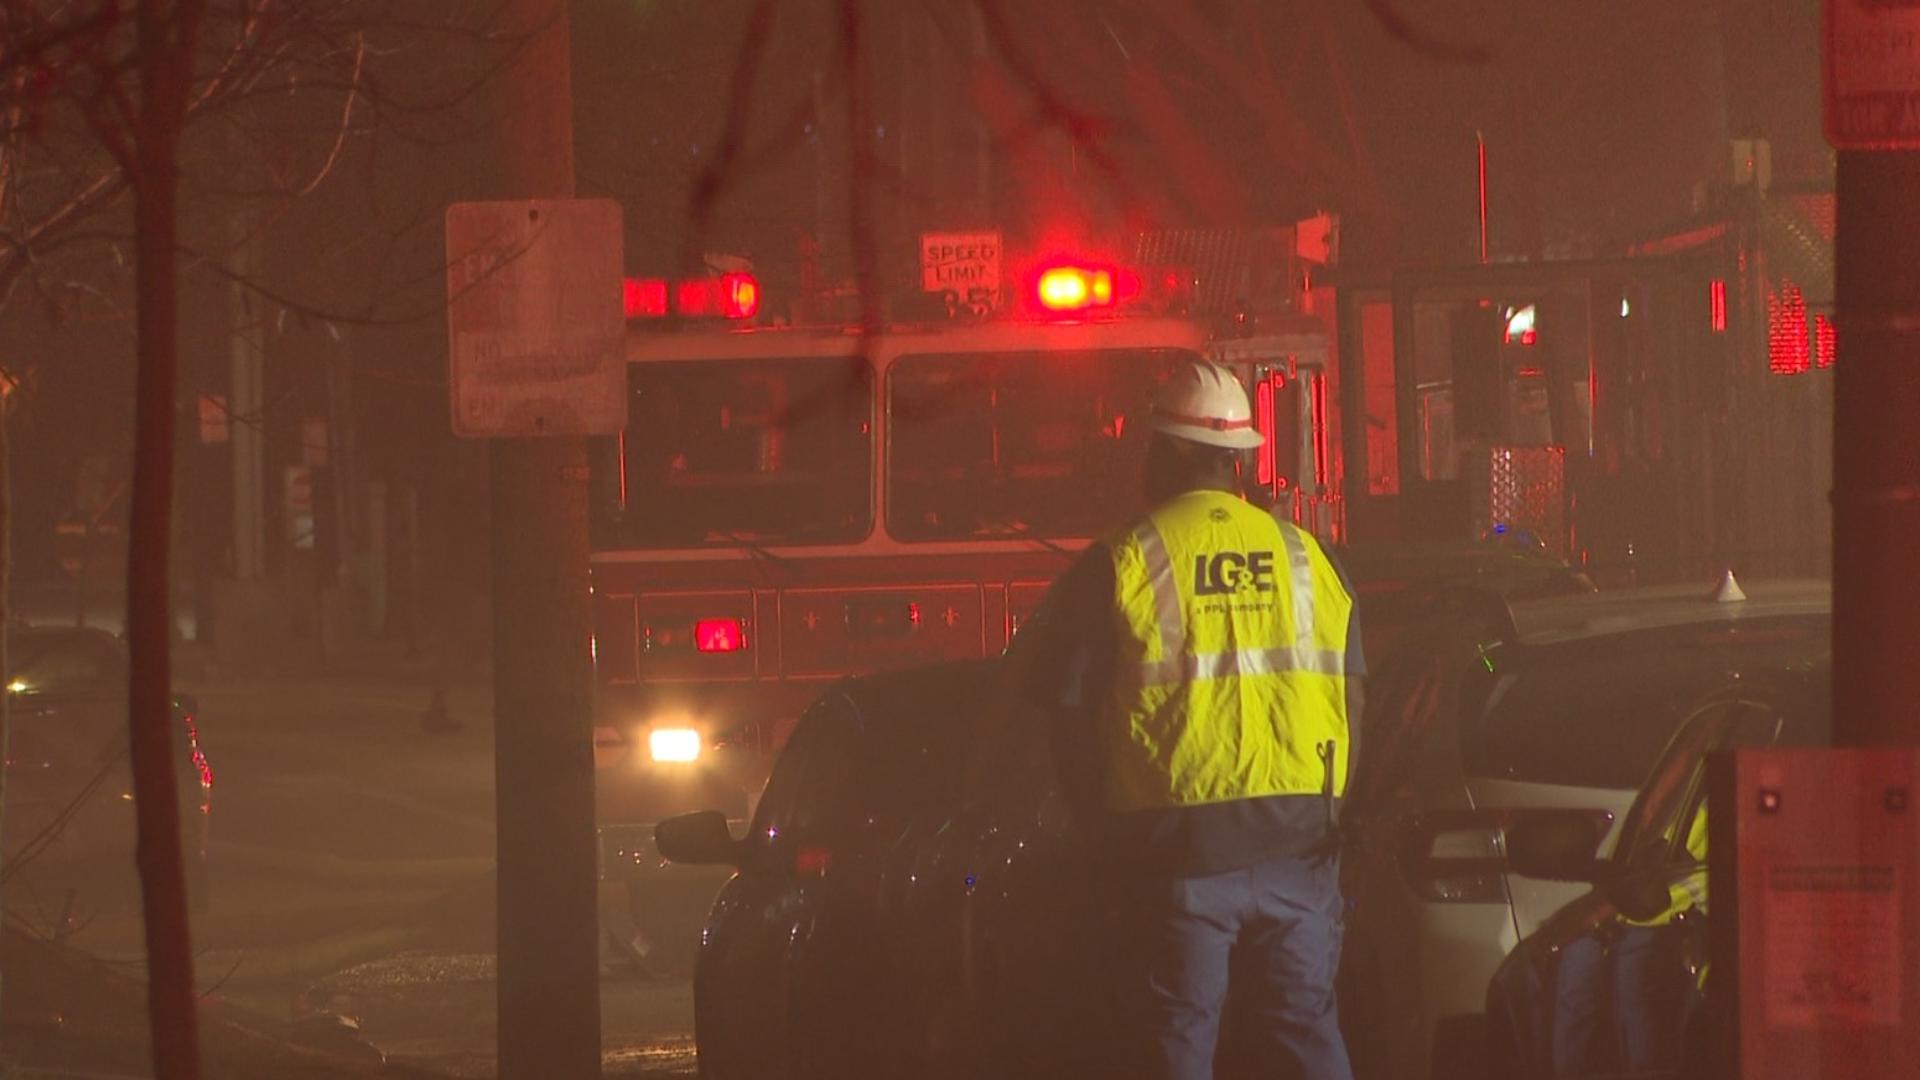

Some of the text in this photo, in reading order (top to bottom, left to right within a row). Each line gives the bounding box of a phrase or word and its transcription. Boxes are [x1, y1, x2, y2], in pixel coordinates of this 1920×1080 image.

[928, 245, 994, 260] SPEED
[936, 264, 985, 281] LIMIT
[1195, 551, 1273, 595] LG&E
